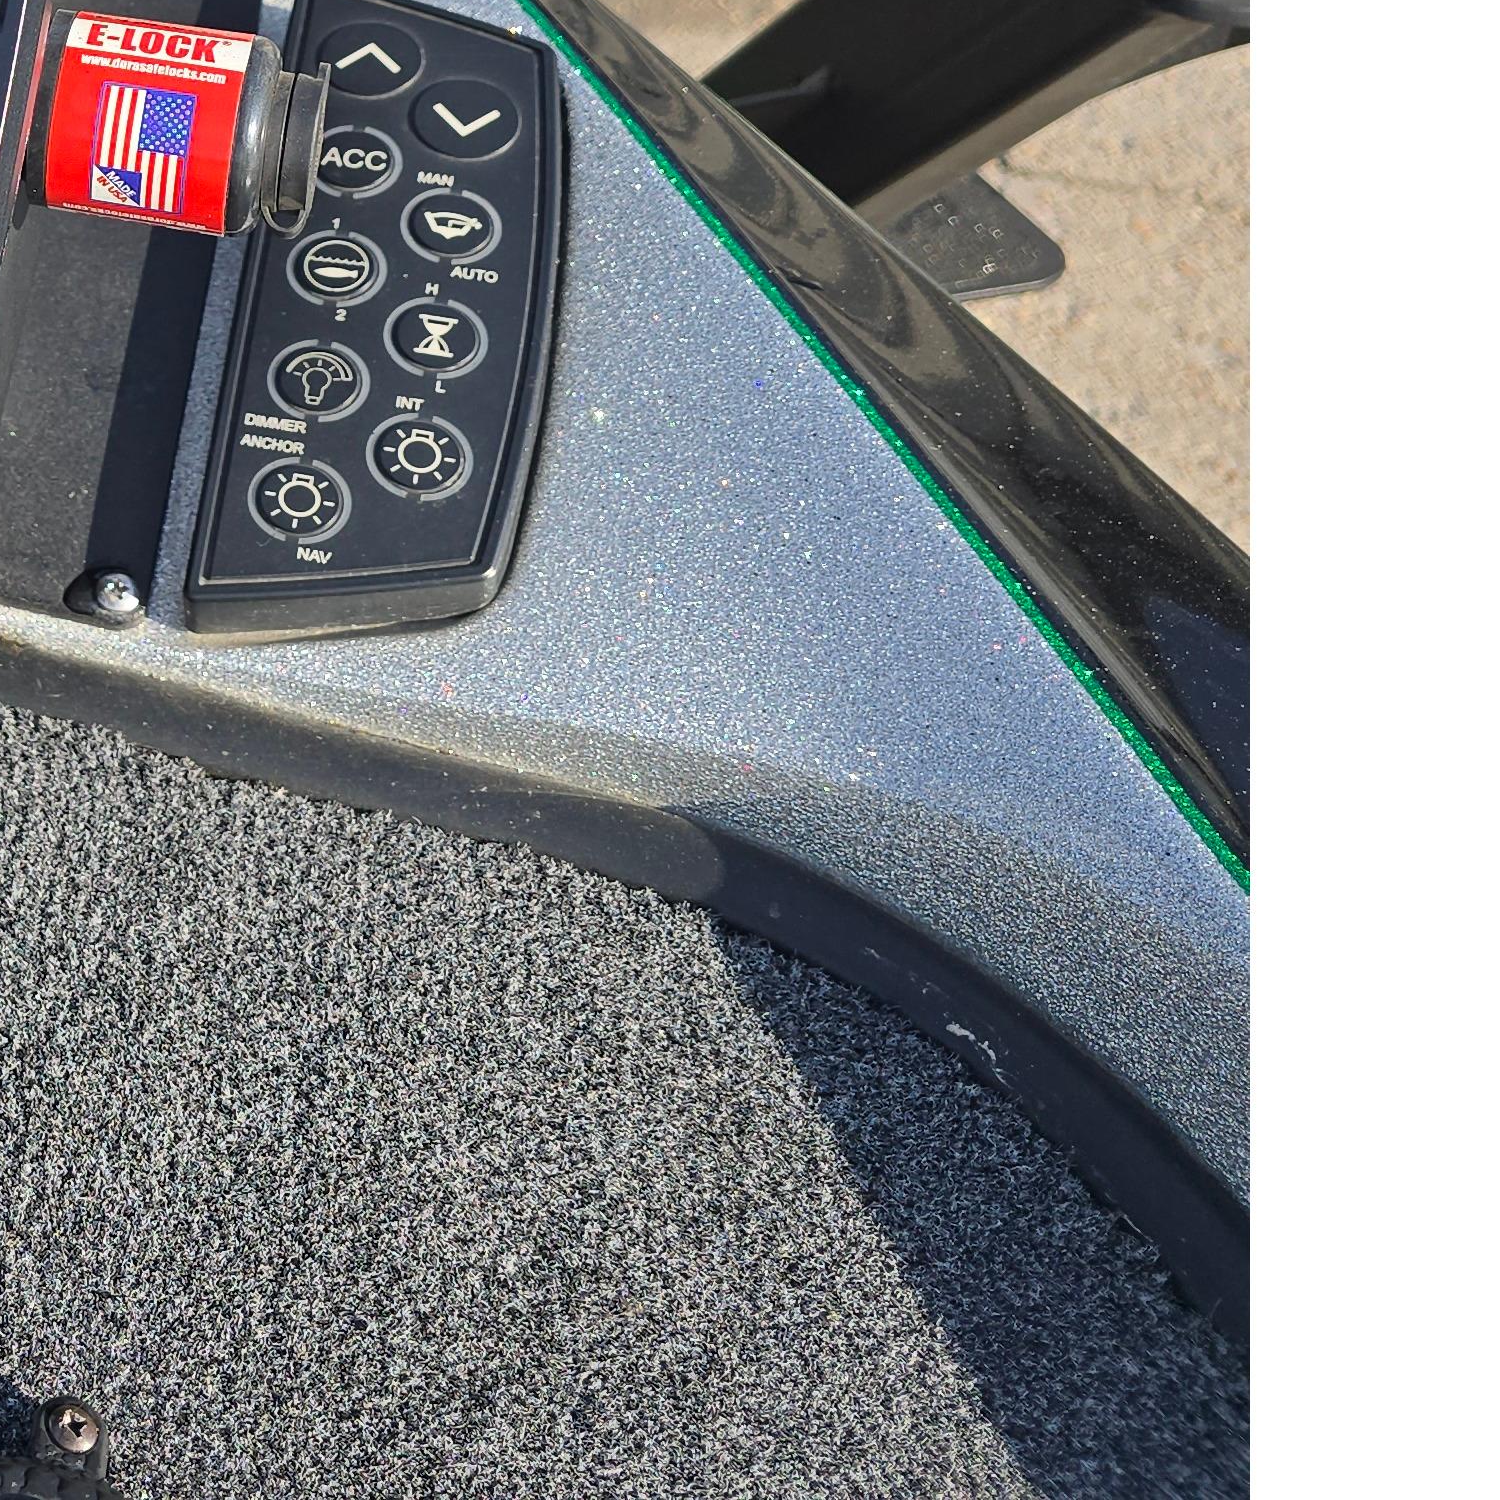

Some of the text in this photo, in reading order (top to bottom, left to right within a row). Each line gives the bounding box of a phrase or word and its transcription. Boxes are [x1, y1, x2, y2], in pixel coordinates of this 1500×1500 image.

[320, 146, 388, 171] ACC
[96, 175, 127, 203] IN USA
[106, 171, 136, 197] MADE
[417, 170, 455, 188] MAN
[332, 217, 341, 230] 1
[450, 264, 499, 284] AUTO
[425, 282, 439, 296] H
[335, 308, 347, 322] 2
[435, 380, 446, 393] L
[396, 395, 425, 412] INT
[244, 412, 307, 434] DIMMER
[239, 433, 306, 455] ANCHOR
[296, 546, 333, 566] NAV
